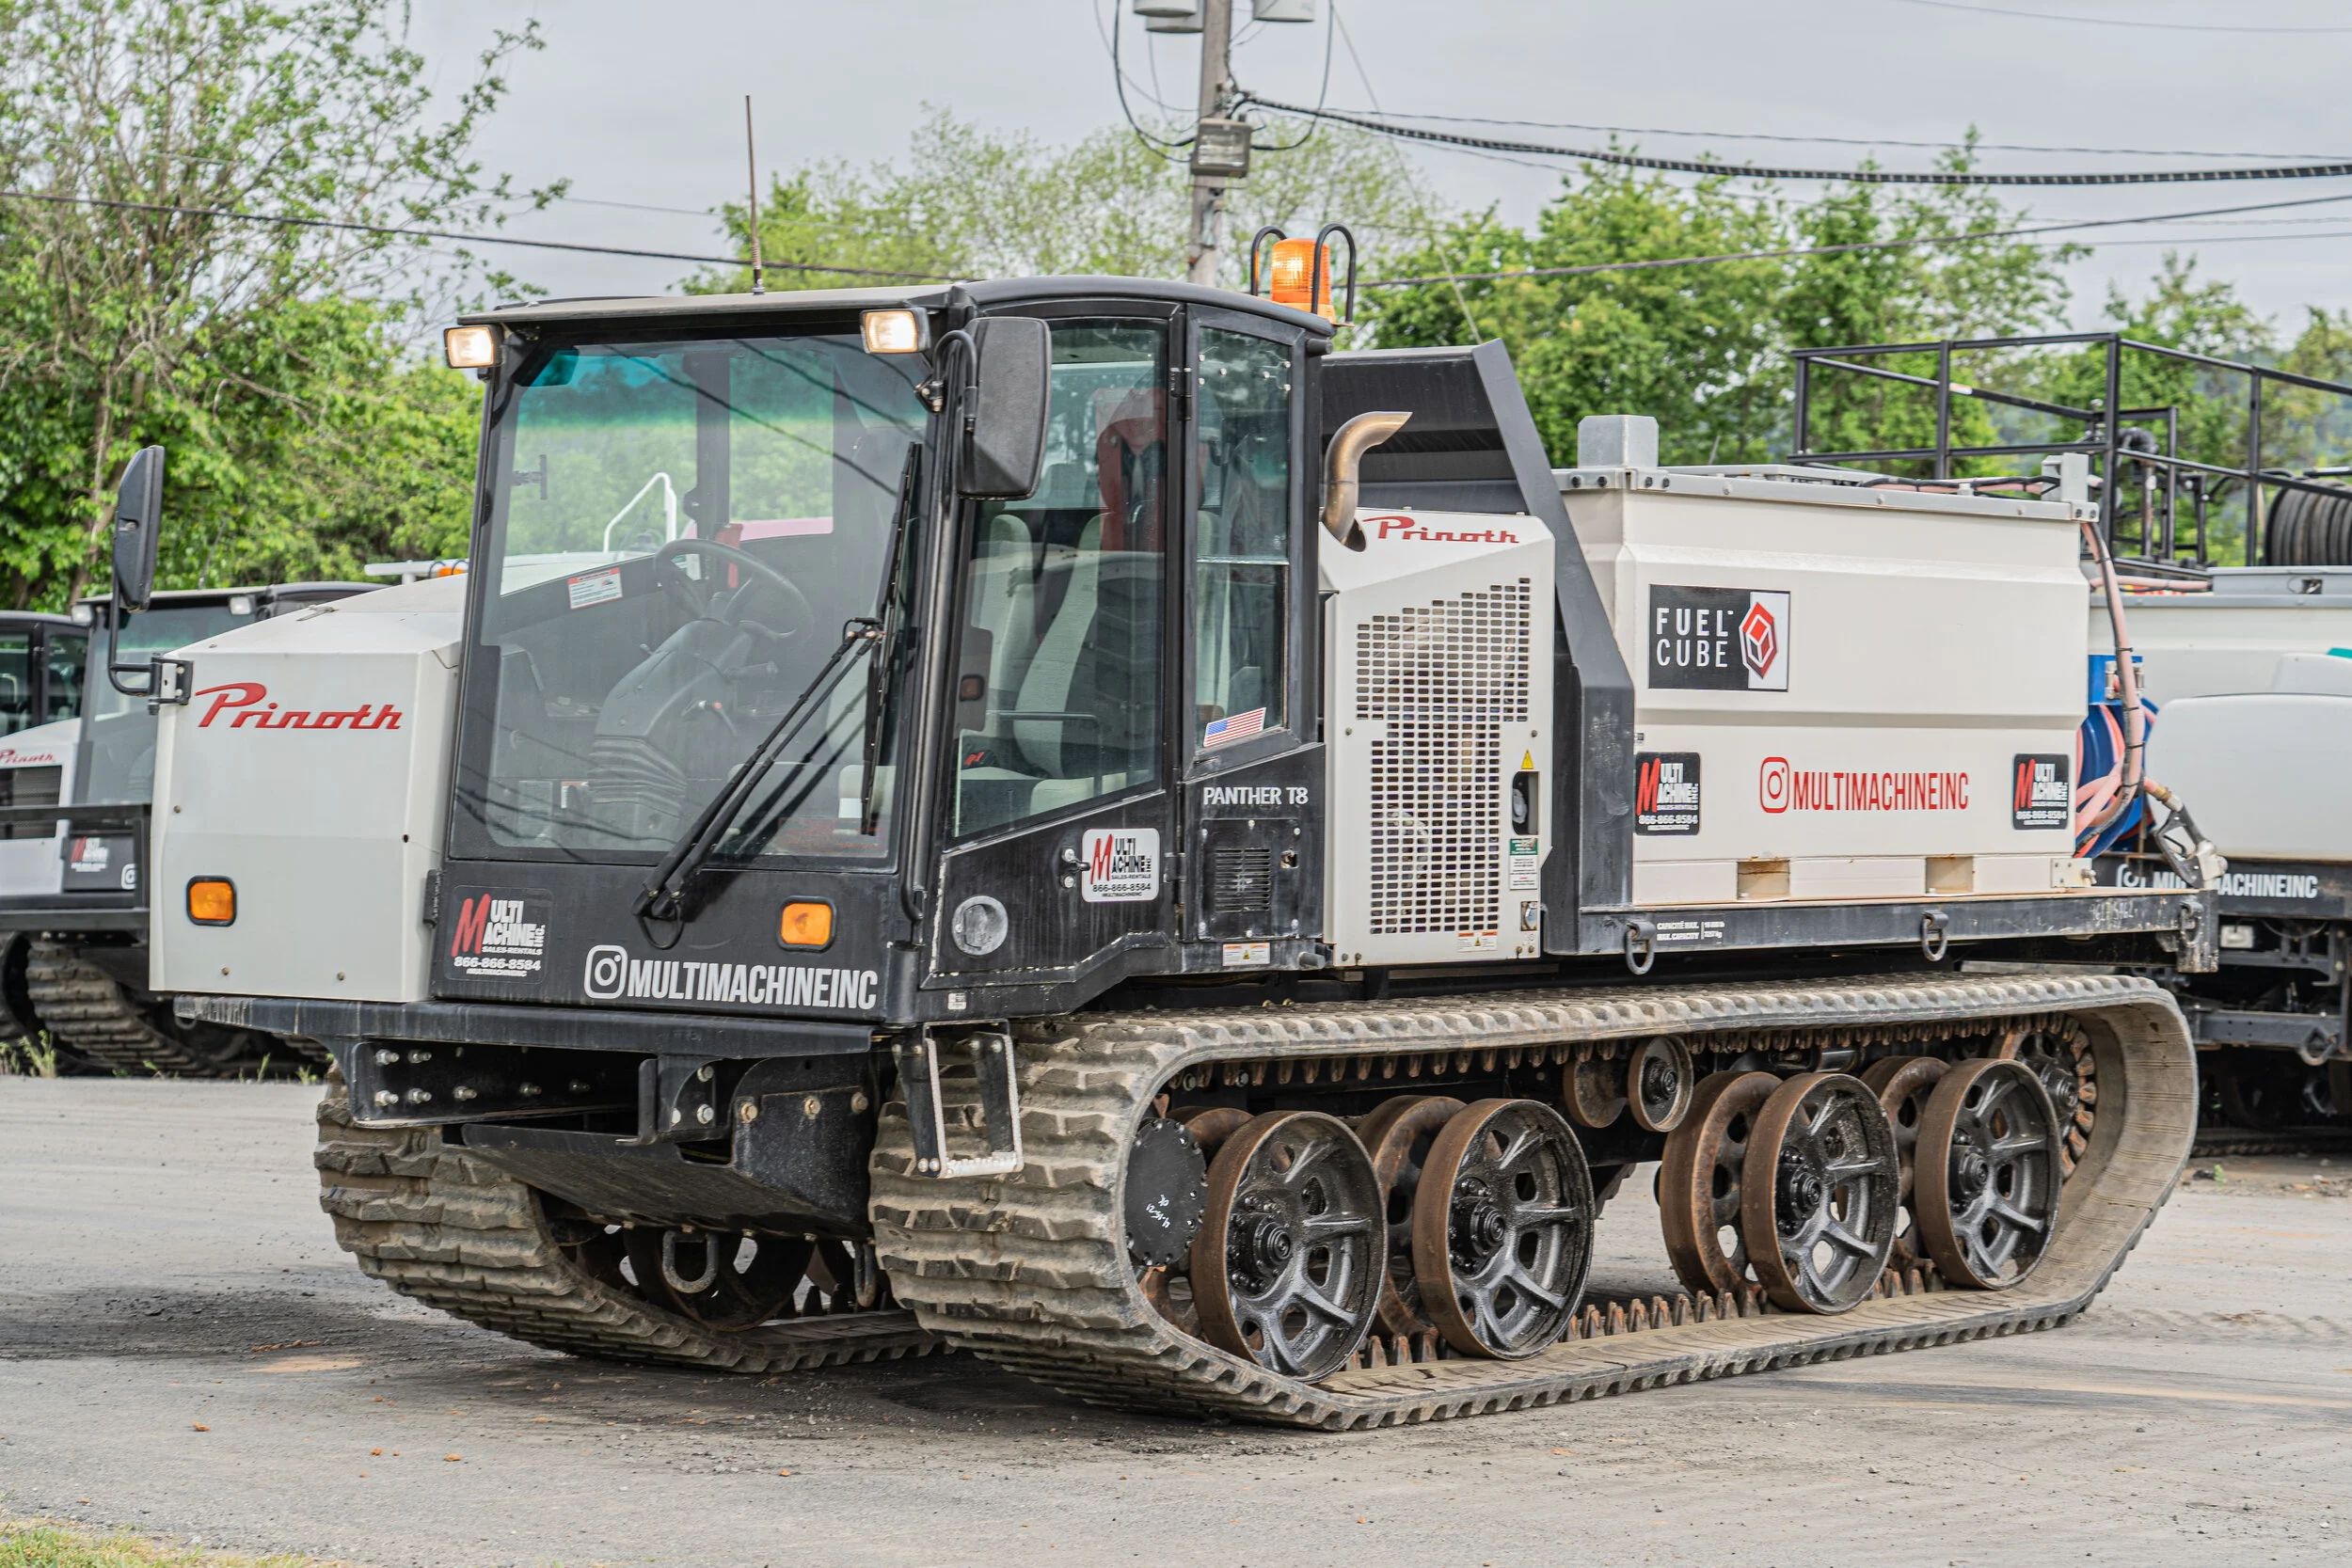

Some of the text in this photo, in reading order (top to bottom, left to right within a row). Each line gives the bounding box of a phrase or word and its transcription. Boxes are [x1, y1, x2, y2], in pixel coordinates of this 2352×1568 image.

[1362, 515, 1519, 544] Prinoth
[1656, 639, 1728, 668] CUBE
[195, 682, 403, 730] Prinoth
[1203, 786, 1309, 805] PANTHER T8
[1793, 771, 1969, 811] MULTIMACHINEINC
[1092, 882, 1152, 893] 866-866-8584
[453, 956, 542, 972] 866-866-8584
[627, 959, 879, 1010] MULTIMACHINEINC
